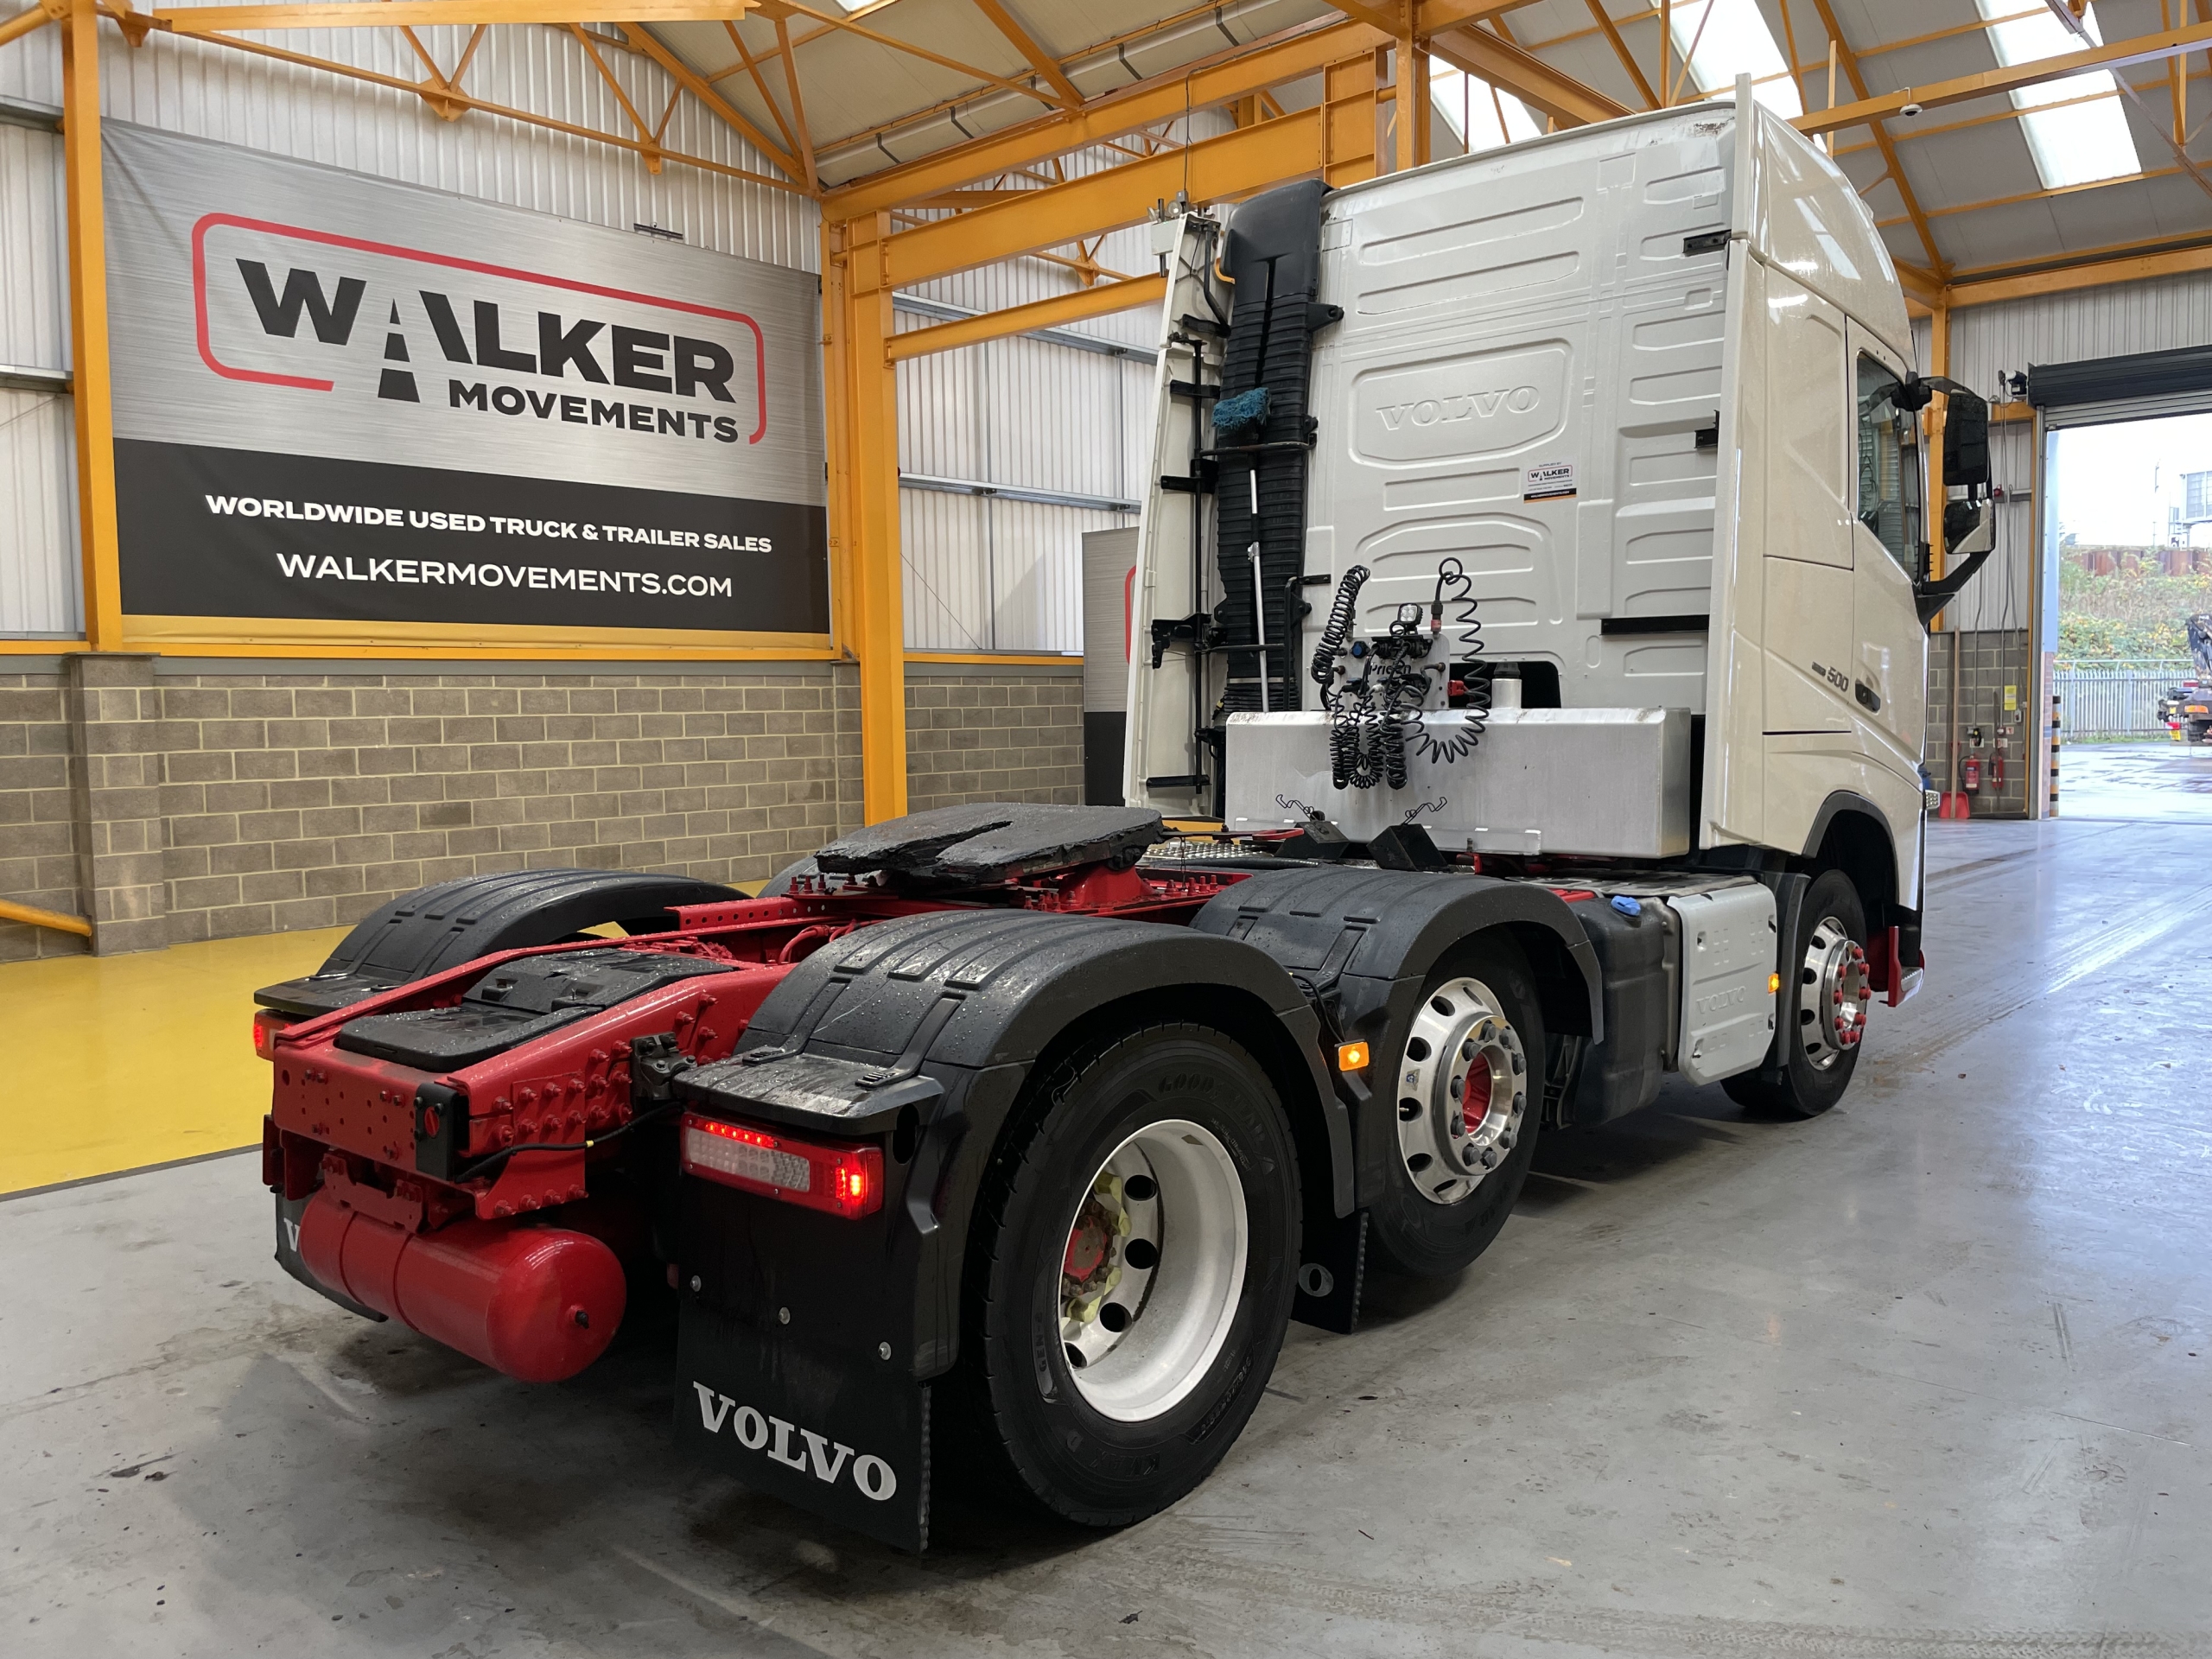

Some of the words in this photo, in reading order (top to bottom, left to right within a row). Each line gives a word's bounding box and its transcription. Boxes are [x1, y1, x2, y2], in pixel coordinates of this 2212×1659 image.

[235, 257, 738, 404] WALKER
[448, 378, 739, 443] MOVEMENTS
[1376, 385, 1541, 431] VOLVO
[1530, 468, 1570, 480] WALKER
[206, 494, 404, 528] WORLDWIDE
[410, 510, 486, 532] USED
[490, 516, 579, 542] TRUCK
[582, 524, 600, 542] &
[602, 525, 701, 549] TRAILER
[704, 533, 772, 553] SALES
[276, 552, 732, 597] WALKERMOVEMENTS.COM
[1827, 665, 1849, 692] 500
[1696, 985, 1746, 1015] VOLVO
[693, 1381, 896, 1501] VOLVO
